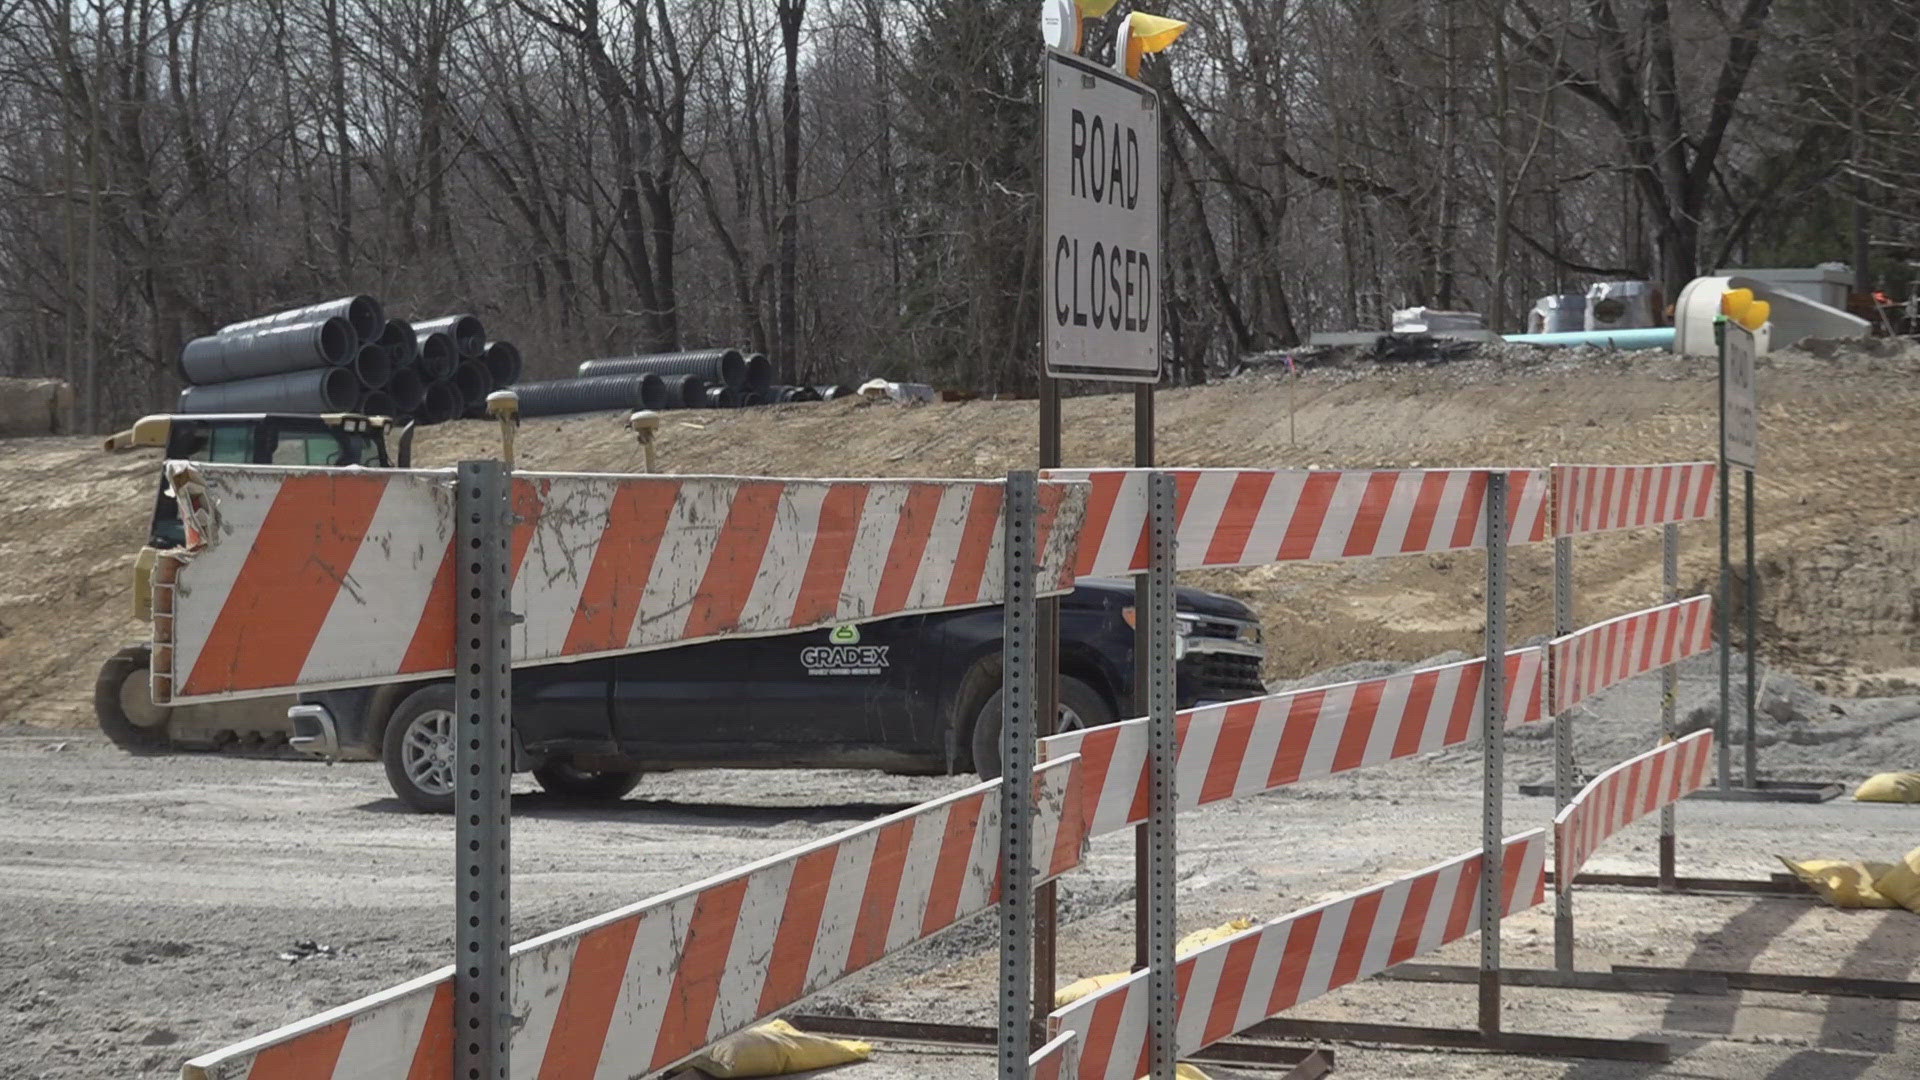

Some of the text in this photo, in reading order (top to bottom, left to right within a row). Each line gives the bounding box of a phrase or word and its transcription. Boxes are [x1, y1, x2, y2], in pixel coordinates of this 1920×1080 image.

[1071, 108, 1139, 210] ROAD
[1055, 235, 1150, 333] CLOSED
[800, 646, 890, 668] GRADEX
